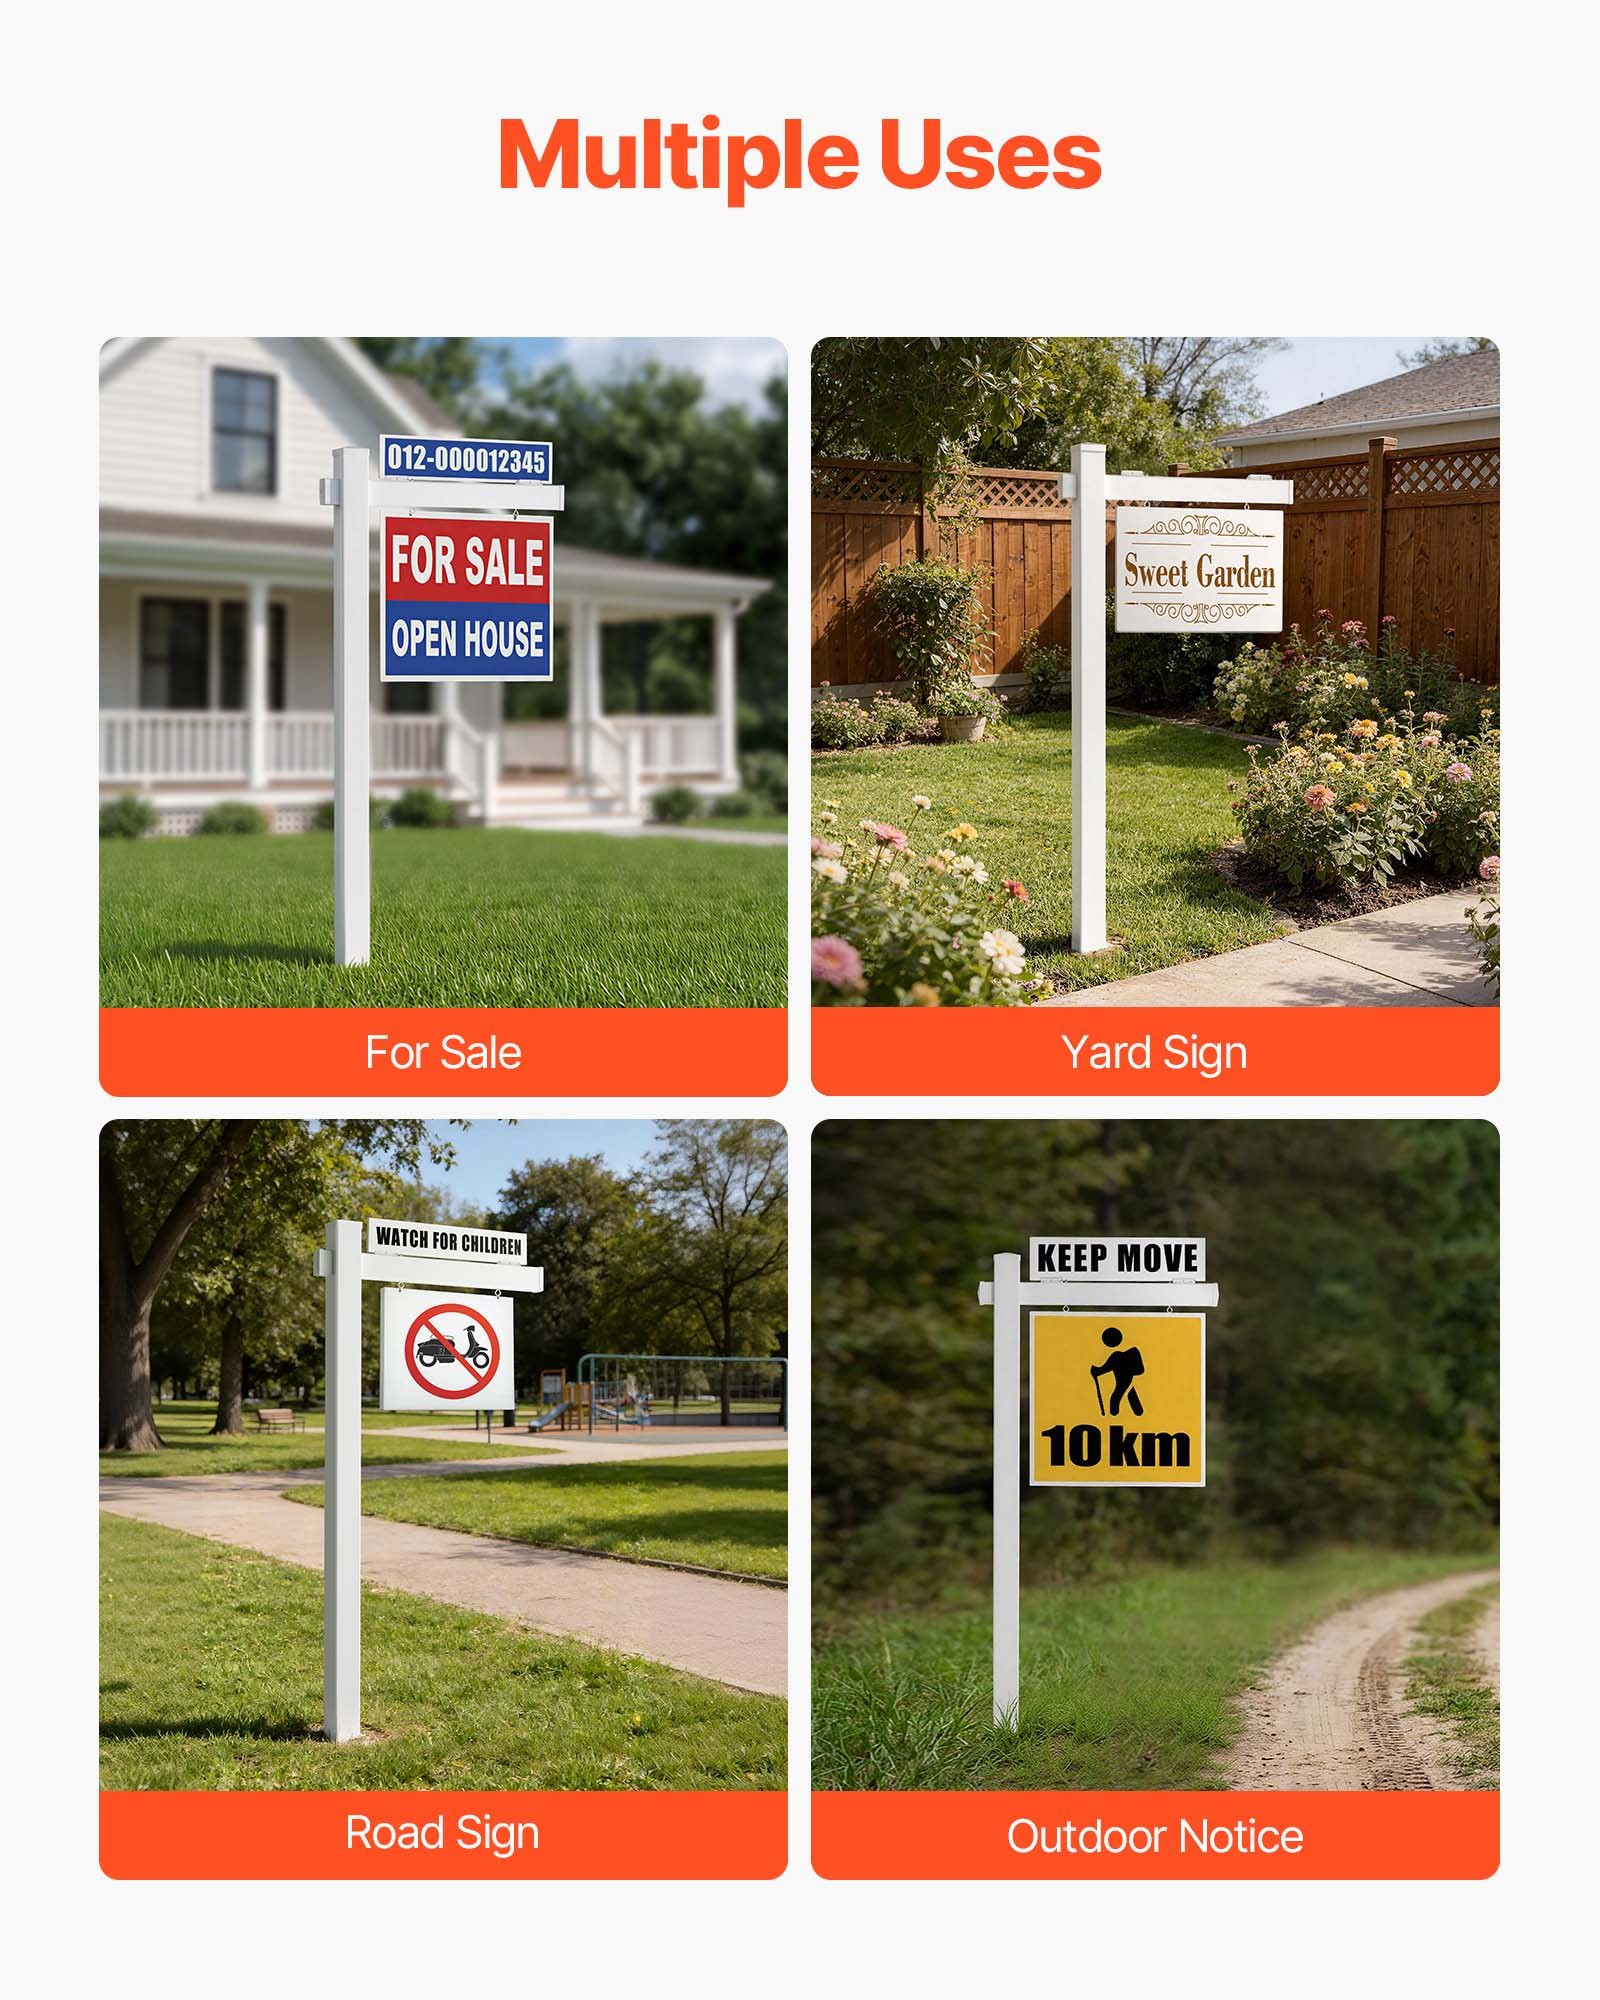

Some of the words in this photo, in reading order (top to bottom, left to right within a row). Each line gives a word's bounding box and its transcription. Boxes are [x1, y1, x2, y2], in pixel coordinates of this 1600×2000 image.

[388, 443, 545, 474] 012-000012345
[392, 534, 456, 584] FOR
[466, 536, 544, 586] SALE
[1124, 551, 1189, 588] Sweet
[1196, 553, 1276, 588] Garden
[392, 618, 457, 657] OPEN
[465, 620, 544, 658] HOUSE
[376, 1226, 428, 1249] WATCH
[433, 1231, 458, 1251] FOR
[461, 1233, 522, 1256] CHILDREN
[1037, 1243, 1107, 1273] KEEP
[1117, 1243, 1198, 1273] MOVE
[1041, 1424, 1102, 1467] 10
[1109, 1425, 1191, 1467] km
